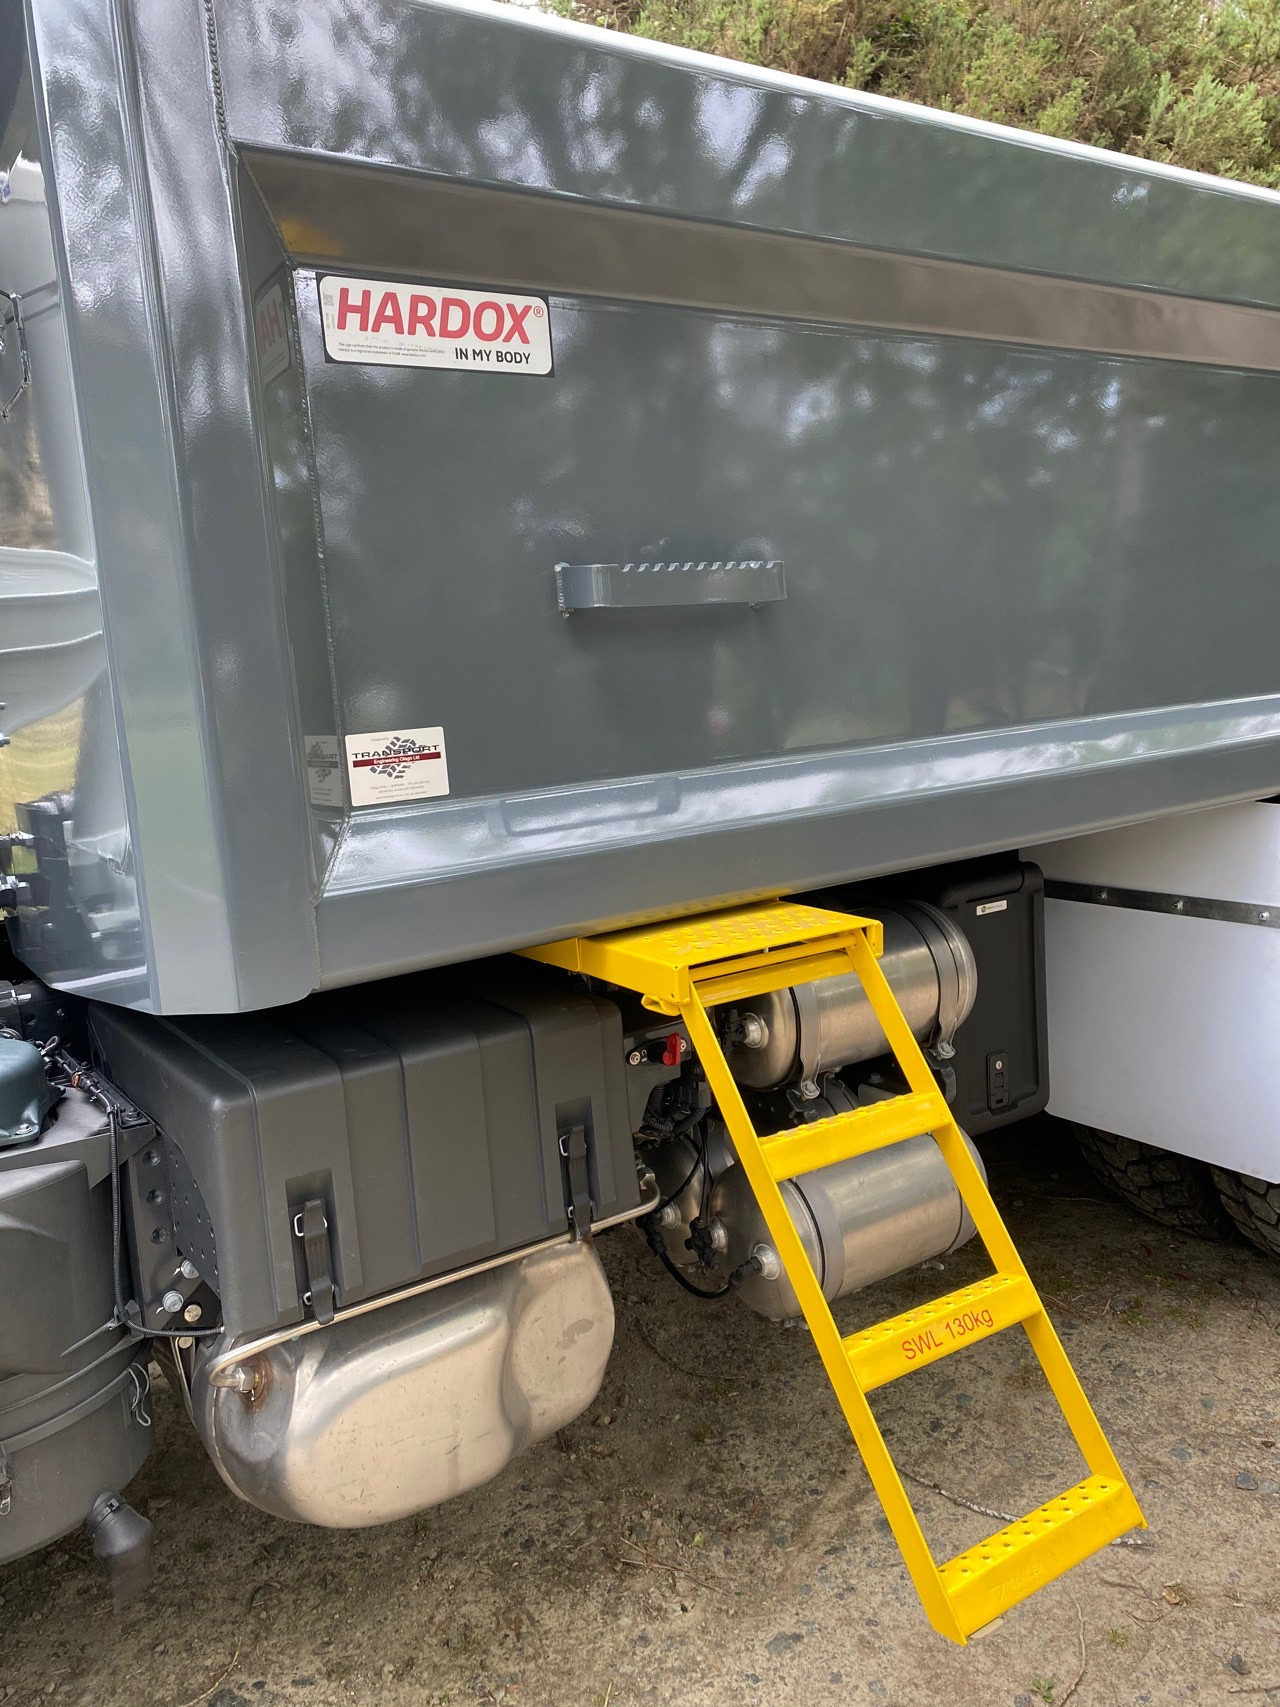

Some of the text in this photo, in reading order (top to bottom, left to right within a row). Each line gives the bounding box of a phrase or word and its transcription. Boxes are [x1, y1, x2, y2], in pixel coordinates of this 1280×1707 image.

[455, 347, 468, 360] IN
[472, 348, 491, 362] MY
[496, 350, 531, 365] BODY
[352, 744, 440, 759] TRANSPORT
[373, 756, 399, 765] Engineering
[902, 1309, 994, 1360] SWL 130kg
